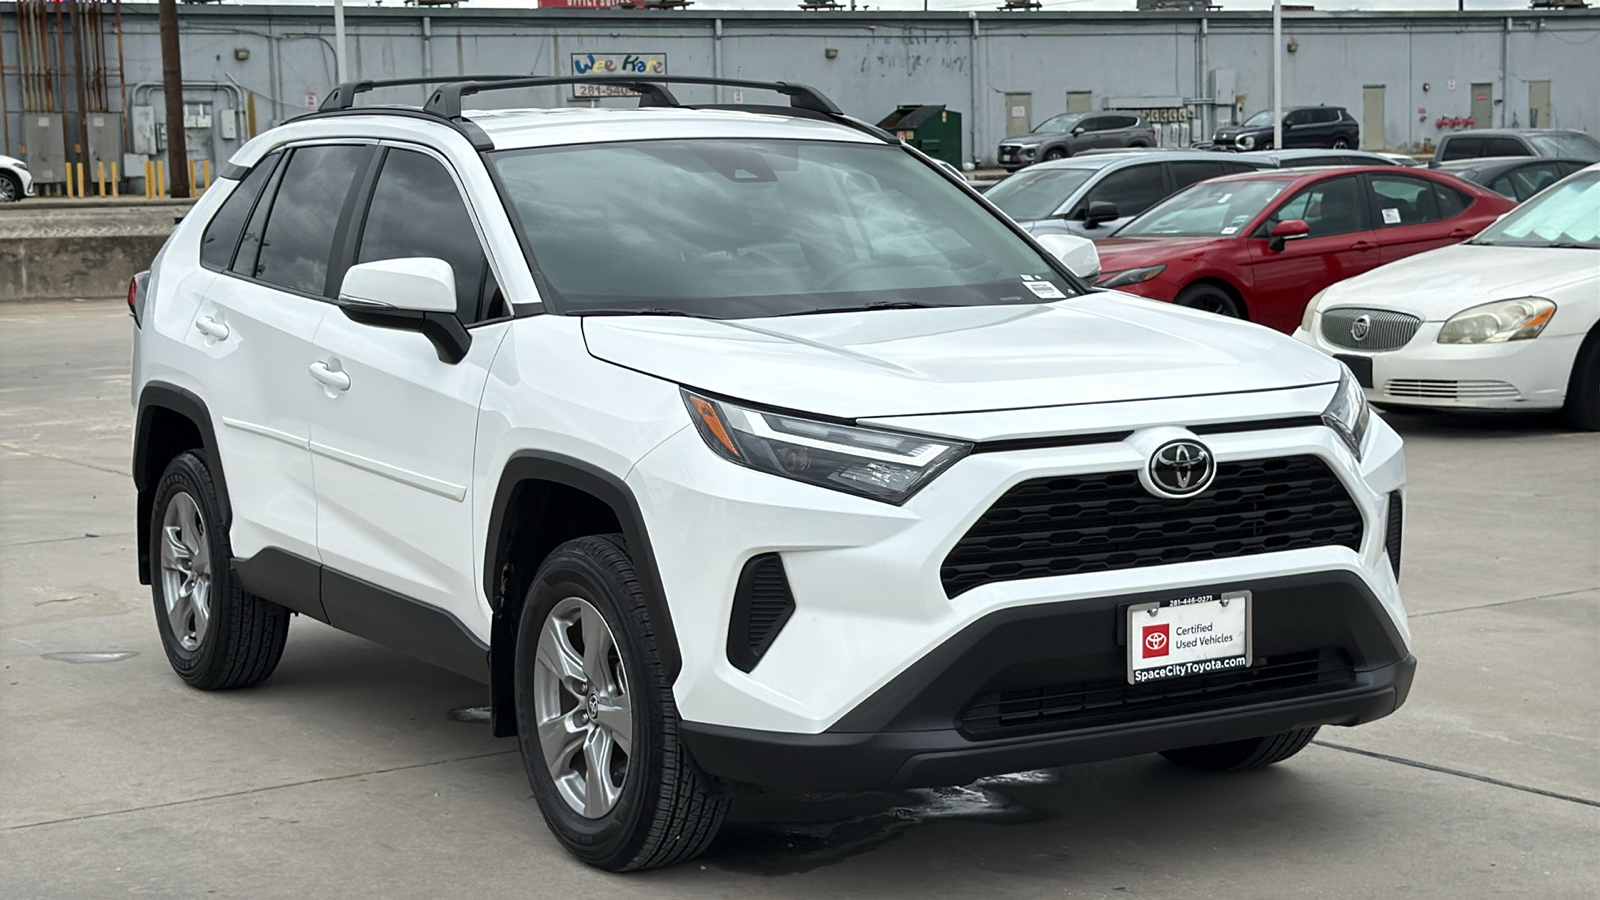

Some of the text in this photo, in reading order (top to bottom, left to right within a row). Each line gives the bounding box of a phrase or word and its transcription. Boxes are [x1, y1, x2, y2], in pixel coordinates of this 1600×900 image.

[575, 54, 664, 74] Wee Kare
[1175, 622, 1213, 636] Certified
[1175, 633, 1233, 649] Used Vehicles
[1135, 657, 1245, 682] SpaceCityToyota.com
